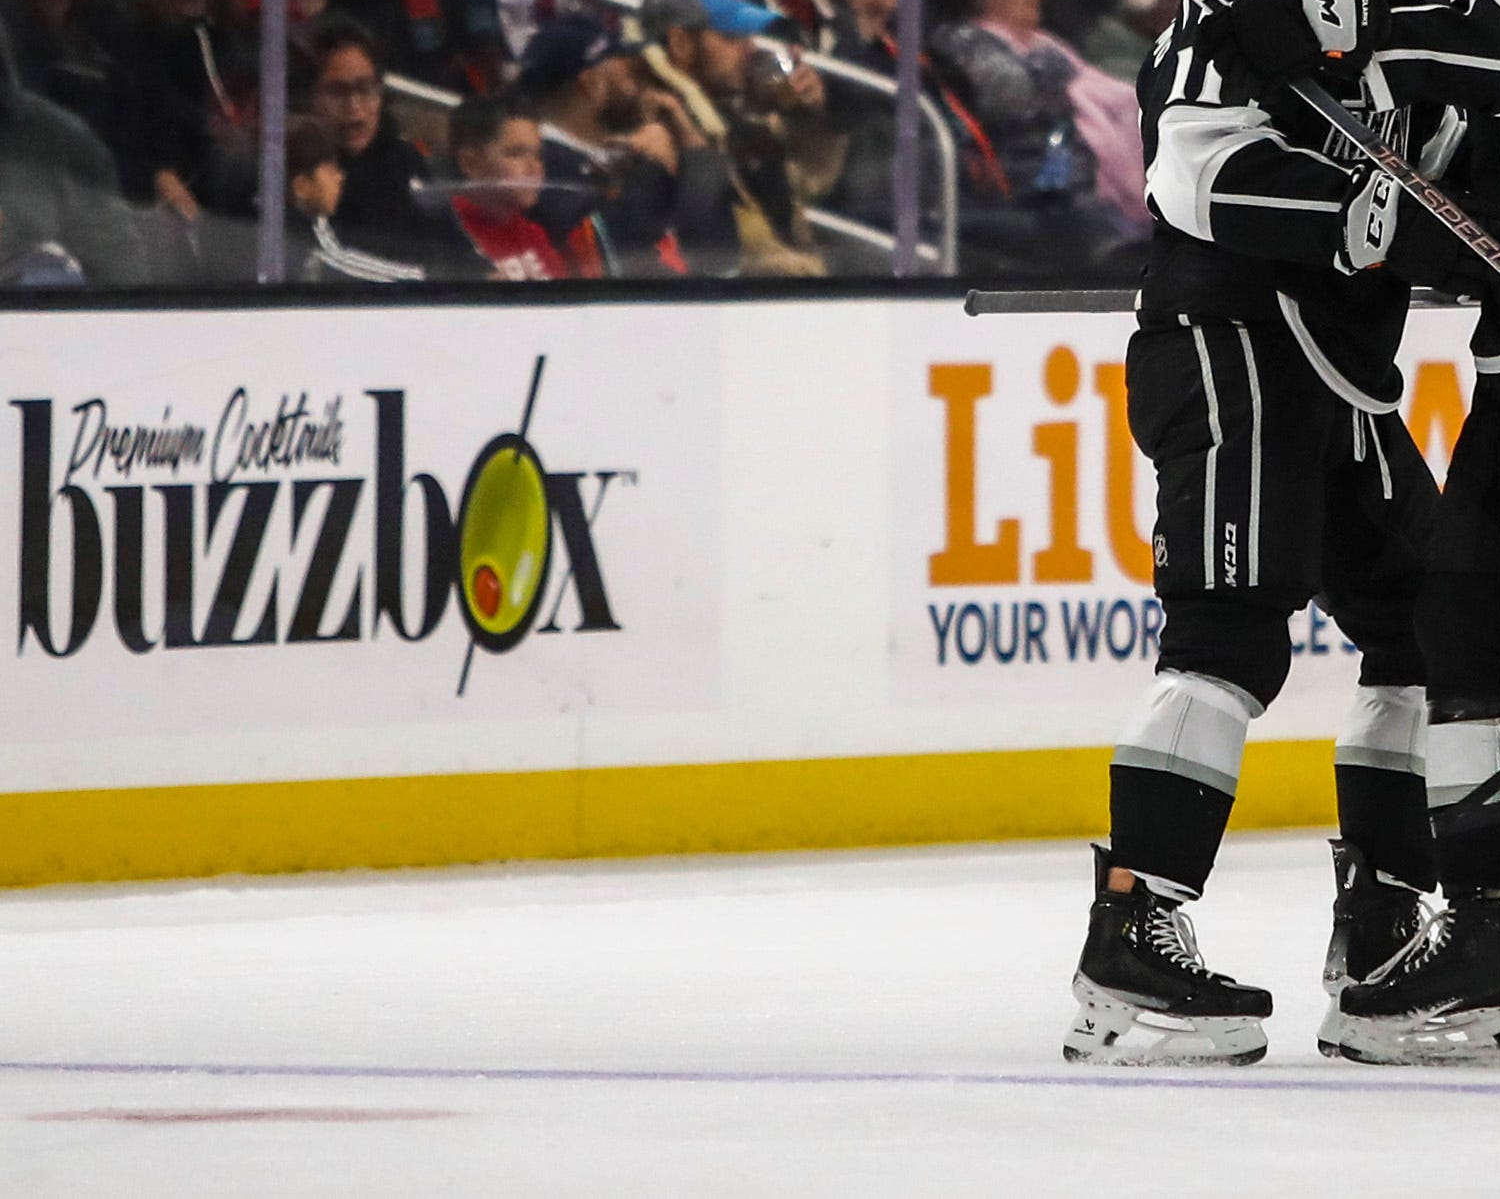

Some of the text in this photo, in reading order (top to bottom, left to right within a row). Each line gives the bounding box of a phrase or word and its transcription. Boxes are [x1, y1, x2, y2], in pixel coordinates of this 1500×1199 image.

[1364, 173, 1395, 250] CC
[64, 386, 344, 484] Premium Cocktails
[9, 387, 624, 658] buzzbox
[1224, 521, 1238, 588] CCM
[929, 601, 1050, 667] YOUR
[1061, 597, 1161, 663] WOR
